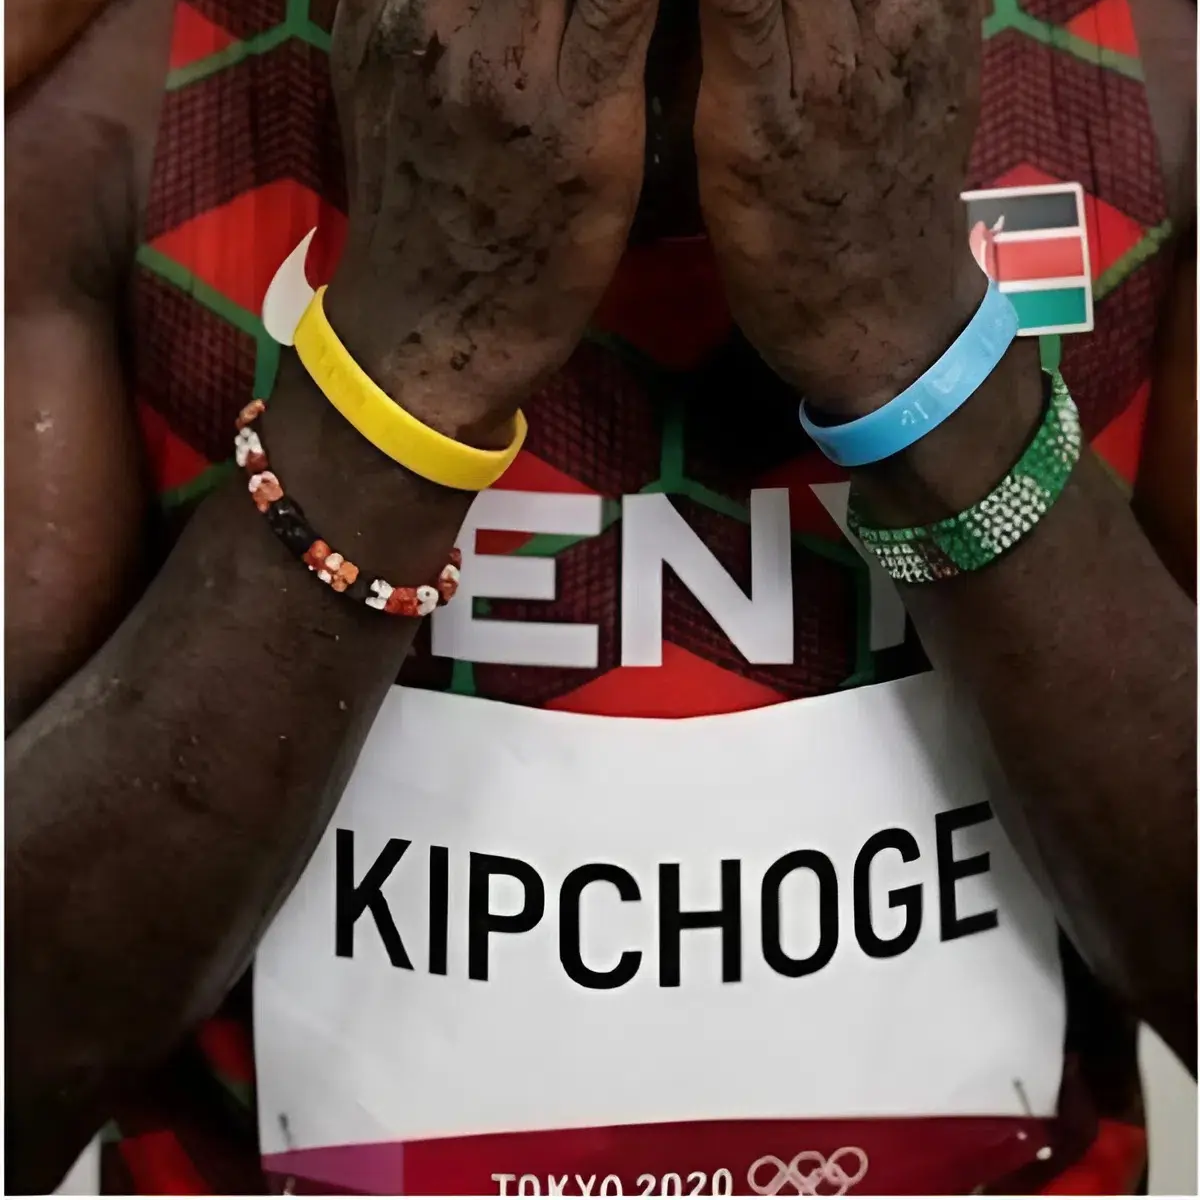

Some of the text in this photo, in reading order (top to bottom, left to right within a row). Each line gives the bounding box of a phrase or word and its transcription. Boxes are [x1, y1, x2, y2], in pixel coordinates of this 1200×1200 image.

[333, 801, 1000, 990] KIPCHOGE
[490, 1167, 734, 1196] TOKYO 2020
